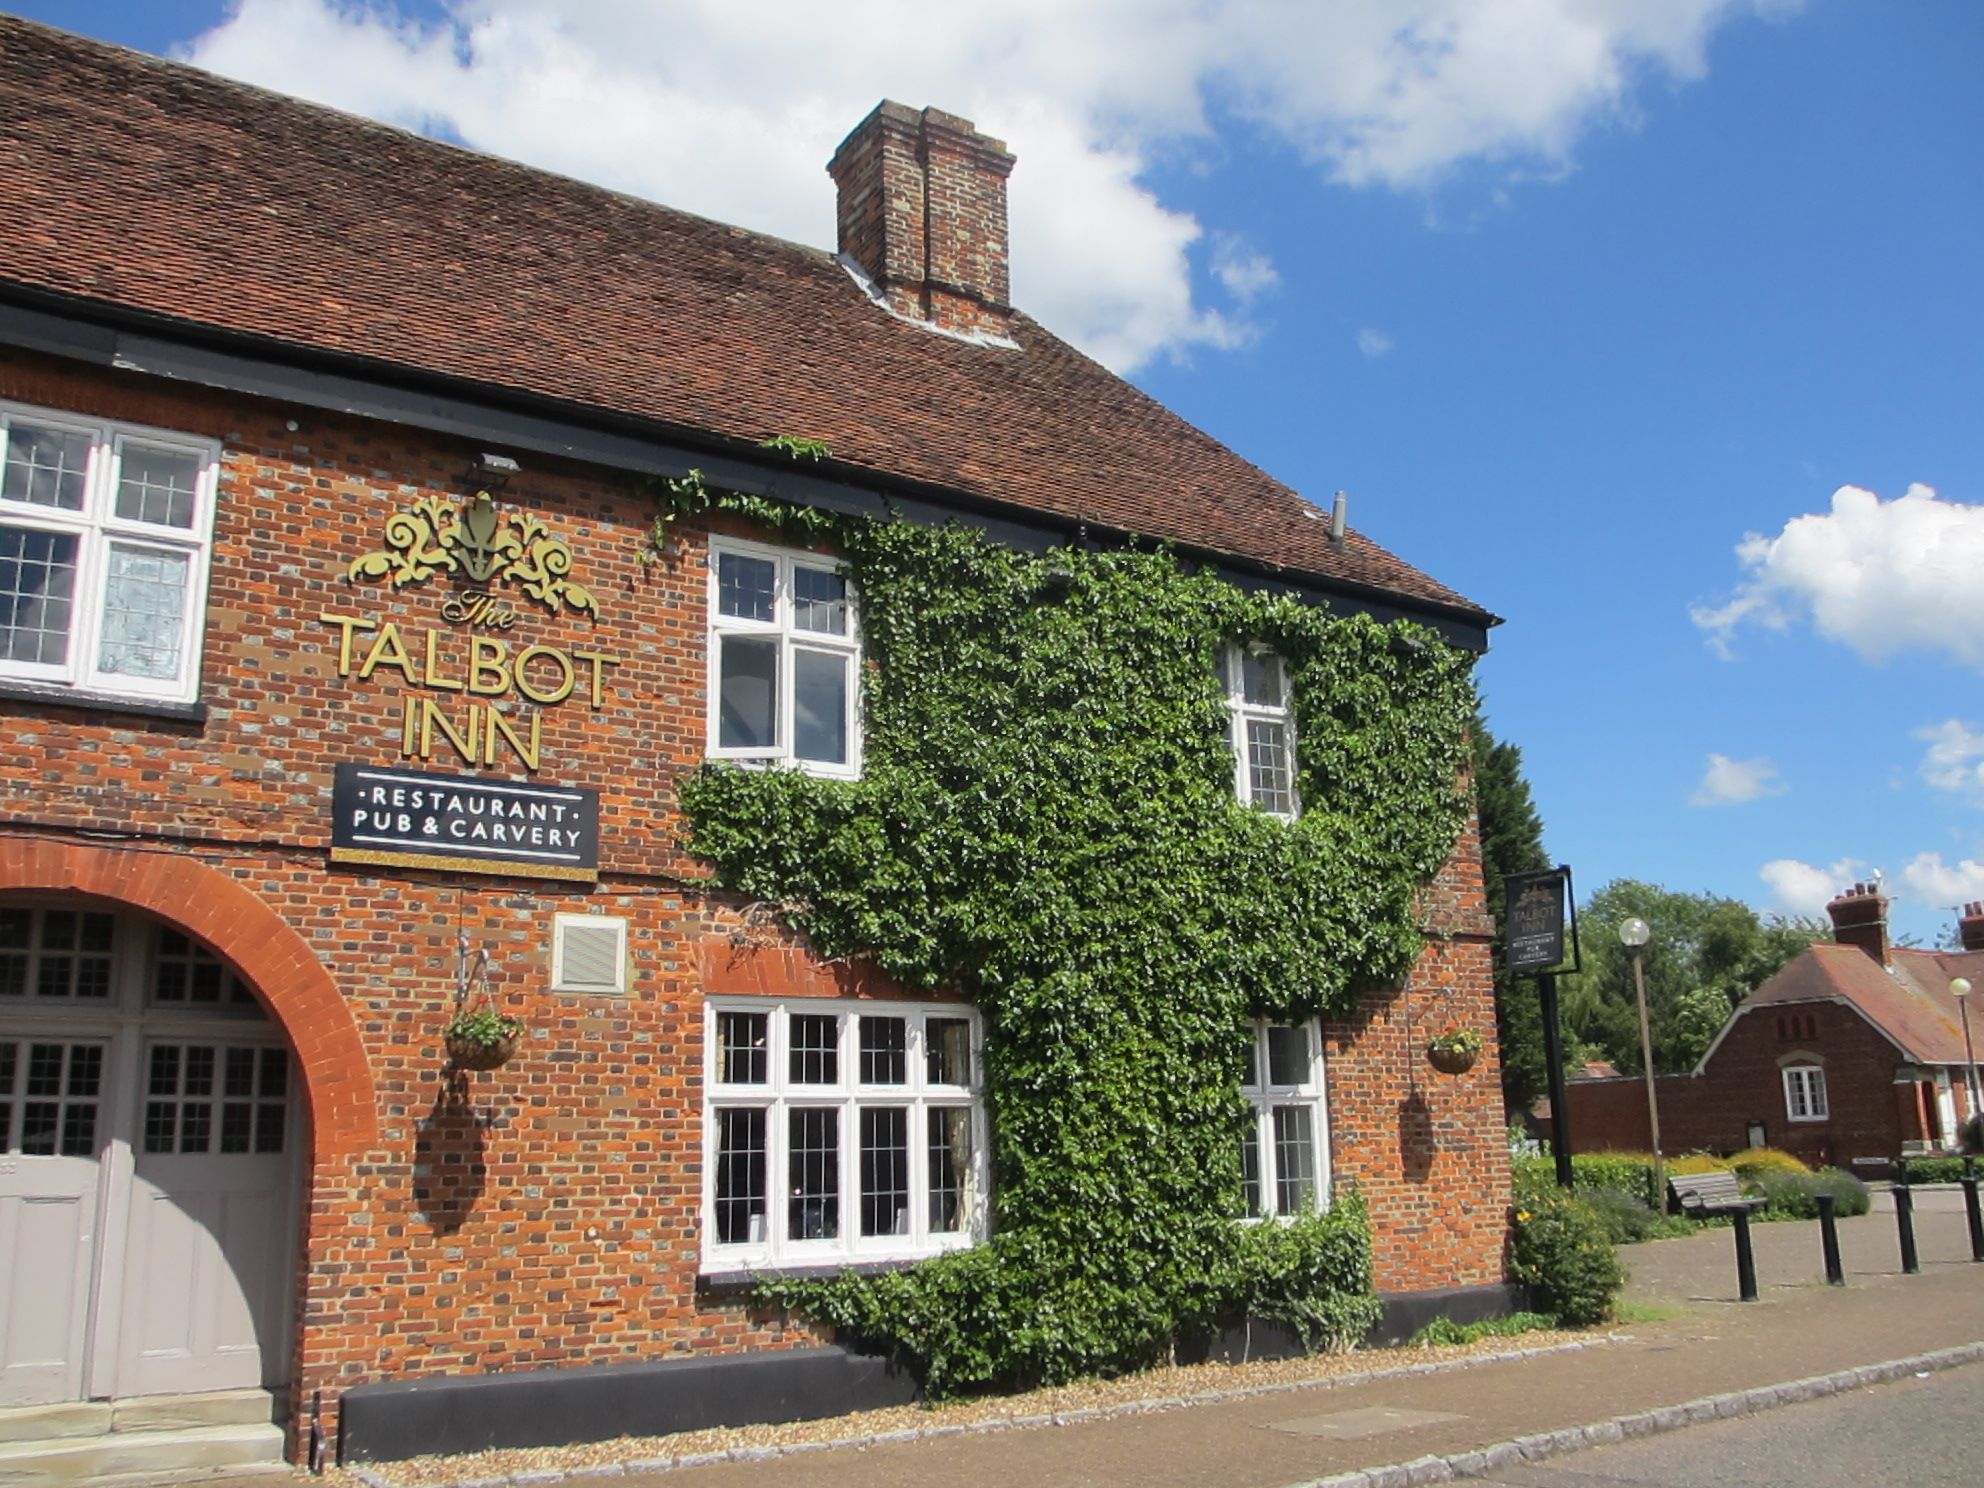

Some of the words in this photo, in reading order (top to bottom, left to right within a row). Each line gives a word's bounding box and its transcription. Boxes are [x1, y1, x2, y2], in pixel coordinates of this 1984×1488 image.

[442, 589, 515, 629] The
[320, 613, 621, 709] TALBOT
[402, 694, 541, 771] INN
[353, 810, 412, 833] PUB
[422, 816, 439, 835] &
[450, 819, 581, 848] CARVERY
